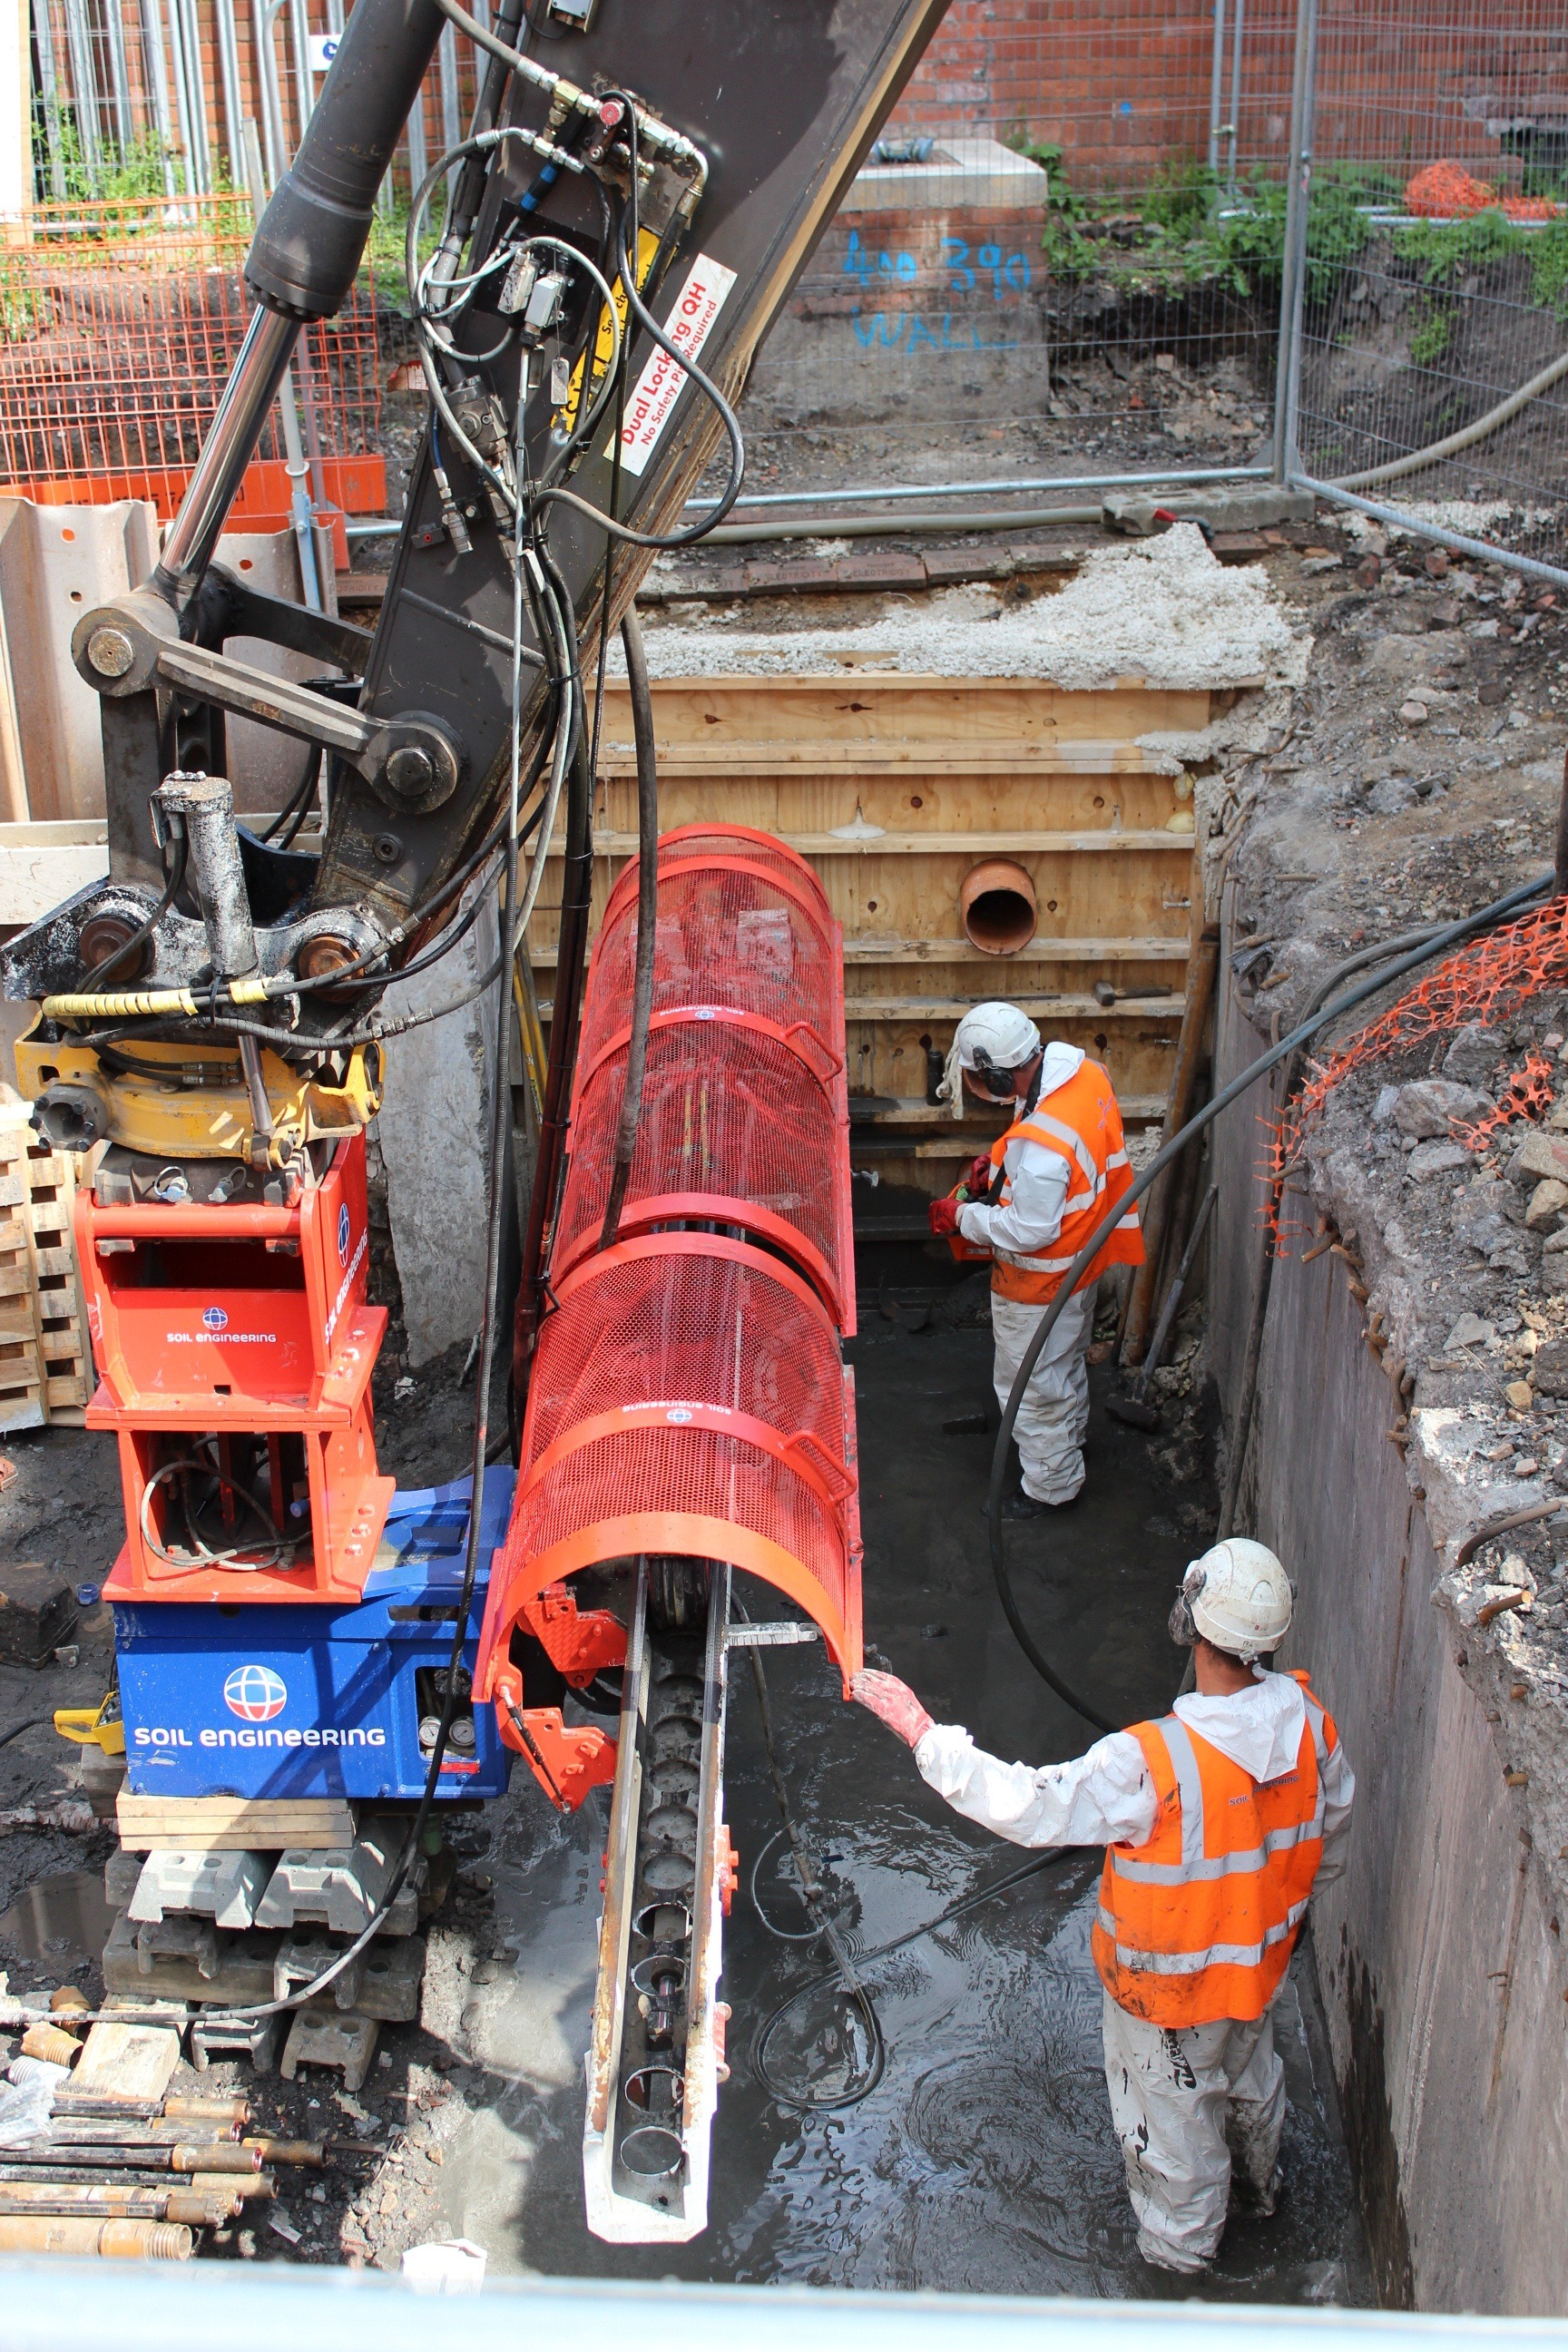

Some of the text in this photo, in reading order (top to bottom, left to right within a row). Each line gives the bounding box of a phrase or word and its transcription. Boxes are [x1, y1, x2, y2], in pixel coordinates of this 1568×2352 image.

[843, 229, 1031, 300] 400 390
[850, 306, 1017, 357] WALL
[622, 281, 707, 445] Dual Lockng QH
[641, 426, 656, 446] No
[654, 384, 678, 424] Safety
[683, 300, 718, 358] Required
[167, 1333, 193, 1343] SOIL
[706, 1404, 731, 1415] SOIL
[134, 1728, 193, 1746] SOIL
